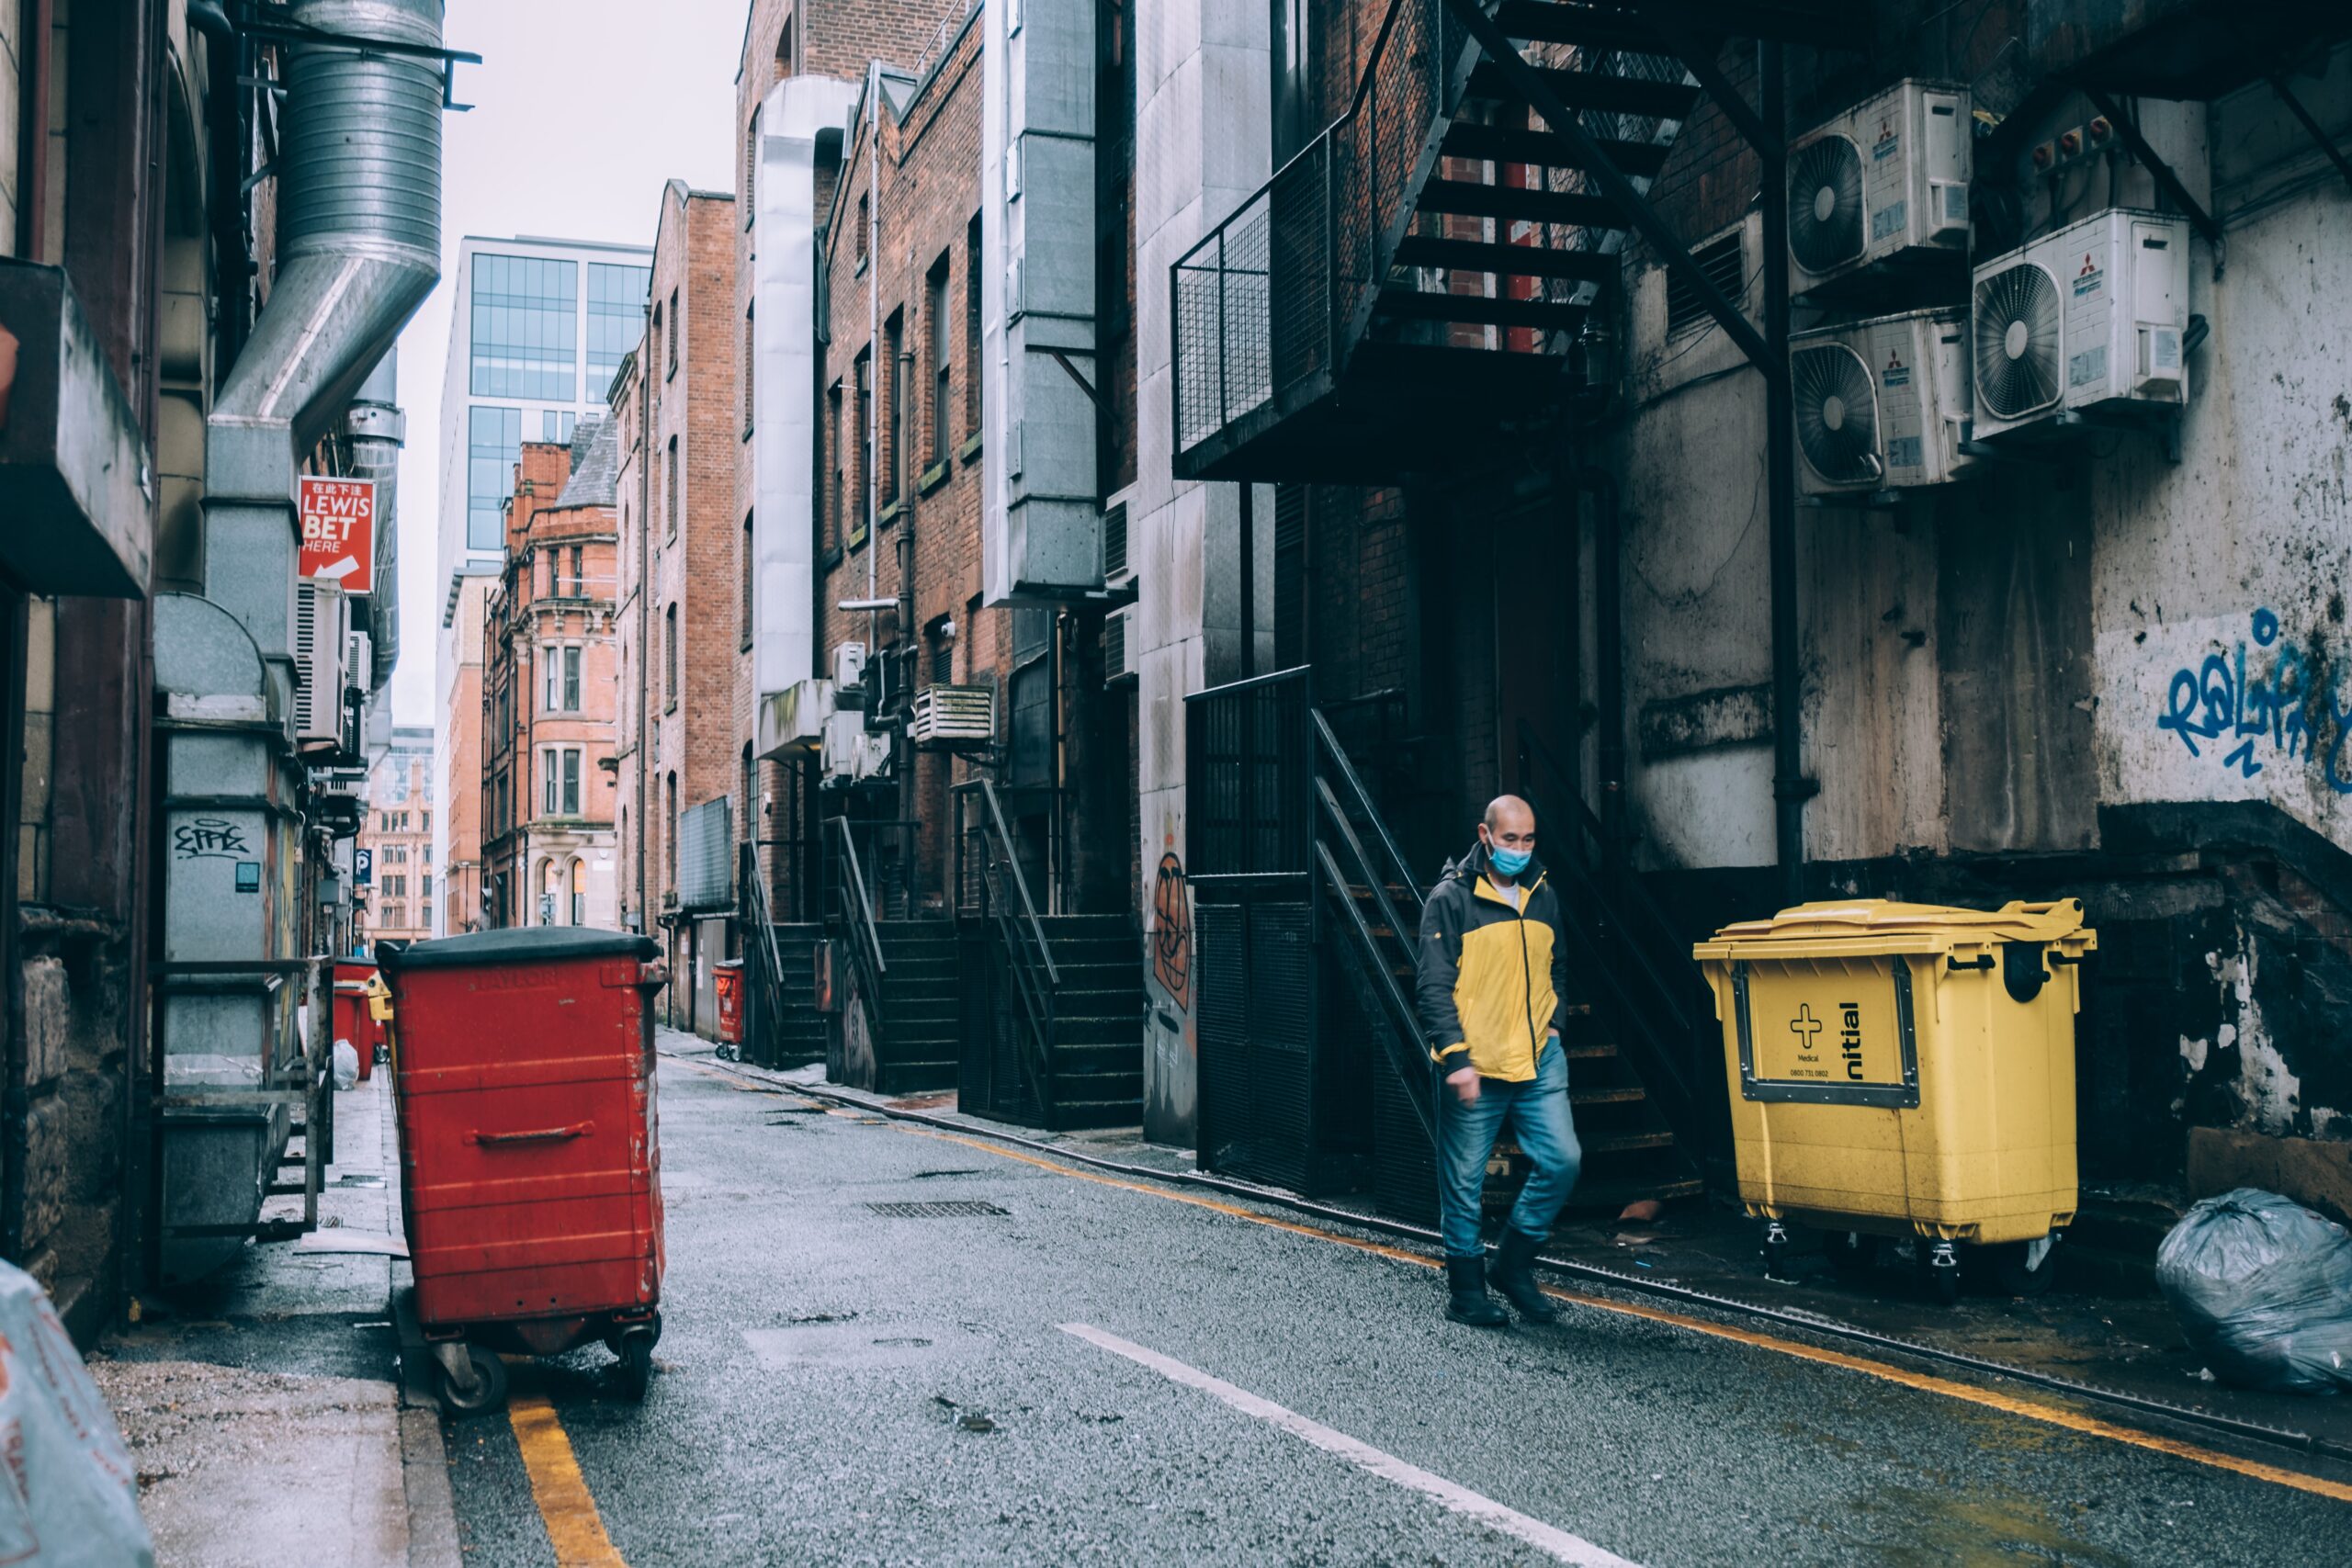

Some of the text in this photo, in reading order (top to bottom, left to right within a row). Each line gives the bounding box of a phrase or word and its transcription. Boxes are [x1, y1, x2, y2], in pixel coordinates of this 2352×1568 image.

[303, 494, 370, 517] LEWIS
[303, 514, 356, 541] BET
[302, 539, 341, 553] HERE
[356, 855, 369, 875] P
[1790, 1068, 1804, 1077] 0800
